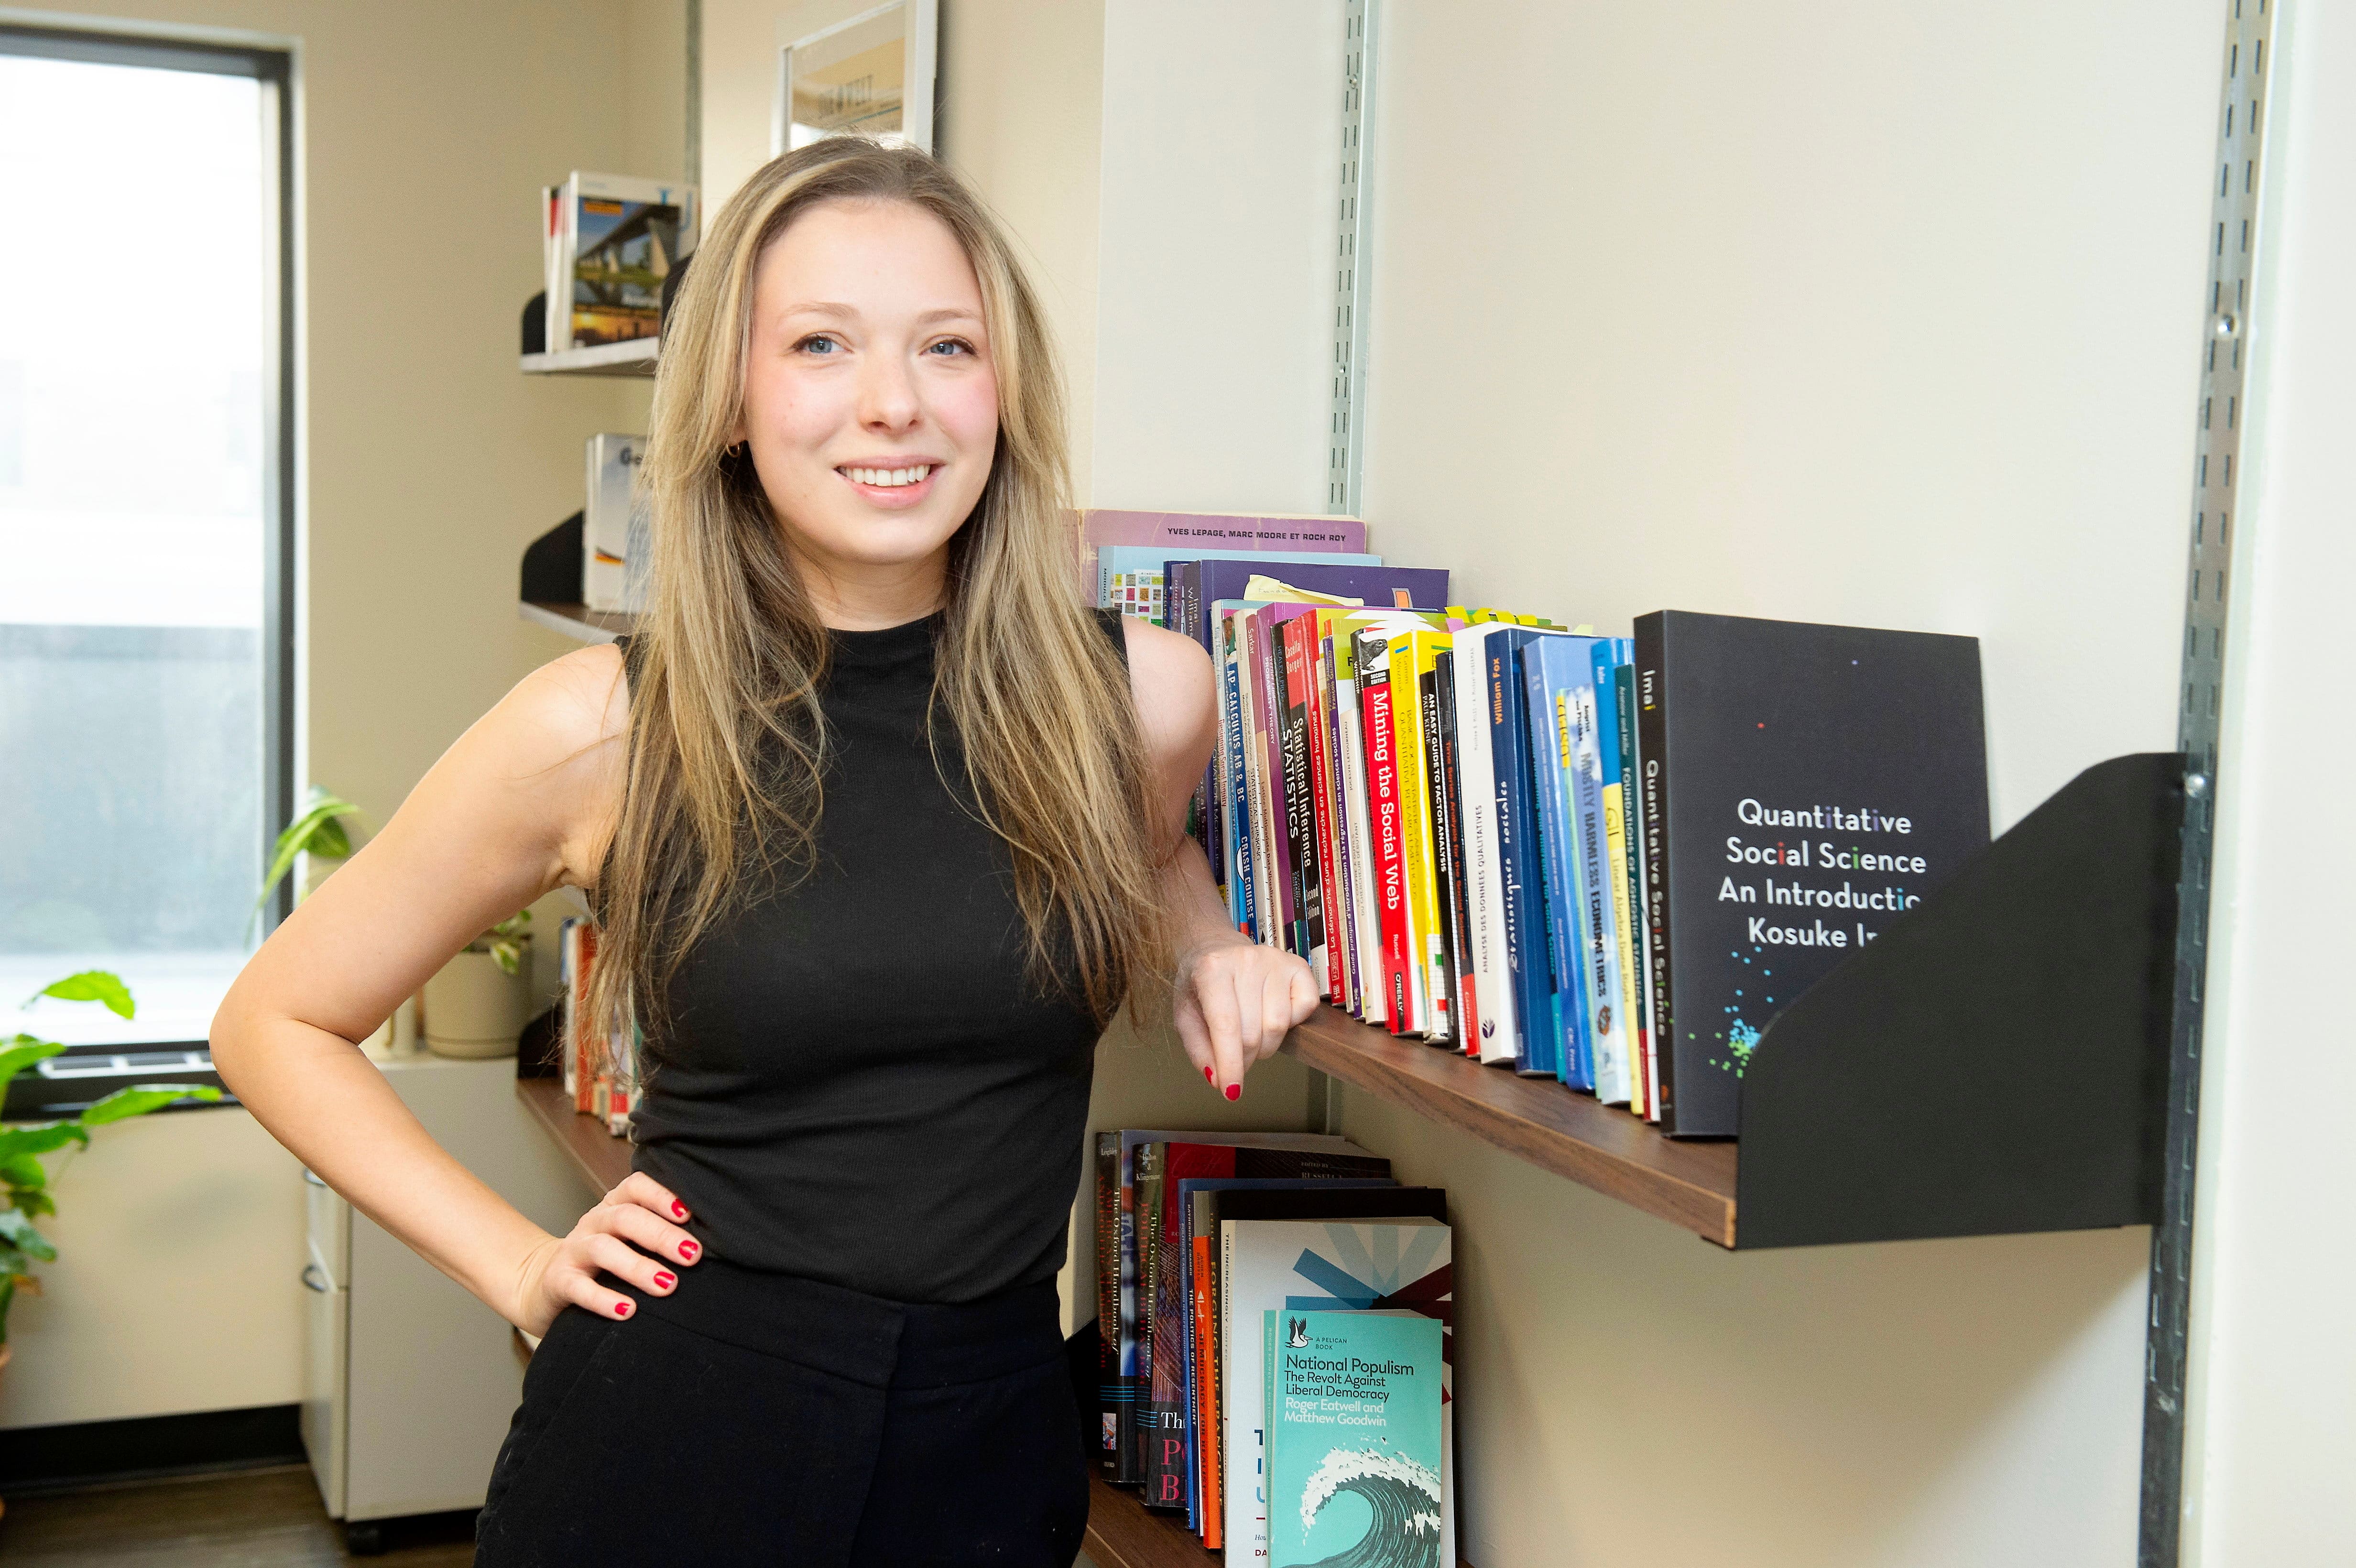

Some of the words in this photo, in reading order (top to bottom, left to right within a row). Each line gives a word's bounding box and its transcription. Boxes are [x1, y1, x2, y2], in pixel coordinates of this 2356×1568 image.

[1192, 529, 1226, 538] LEPAGE,
[1285, 640, 1301, 658] Casella
[1286, 657, 1302, 674] Berger
[1265, 656, 1273, 710] PROBABILITY
[1370, 671, 1386, 679] SECOND
[1643, 670, 1657, 710] Imai
[1229, 691, 1240, 749] CALCULUS
[1494, 682, 1503, 725] William
[1374, 690, 1390, 762] Mining
[1234, 754, 1243, 769] AB
[1294, 717, 1309, 795] Statistical
[1316, 755, 1324, 794] sciences
[1236, 773, 1243, 782] &
[1237, 787, 1244, 803] BC
[1283, 729, 1298, 838] STATISTICS
[1337, 791, 1342, 802] en
[1379, 765, 1392, 798] the
[1428, 693, 1435, 708] AN
[1434, 768, 1440, 783] TO
[1438, 826, 1447, 872] ANALYSIS
[1581, 752, 1595, 806] MOSTLY
[1320, 796, 1324, 808] en
[1496, 781, 1510, 843] sociales
[1622, 767, 1635, 853] FOUNDATIONS
[1737, 798, 1912, 834] Quantitative
[1299, 797, 1311, 867] Inference
[1320, 809, 1328, 859] recherche
[1381, 802, 1397, 861] Social
[1475, 805, 1484, 867] QUALITATIVES
[1646, 759, 1660, 885] Quantitative
[1241, 836, 1250, 873] CRASH
[1341, 845, 1346, 854] la
[1584, 812, 1600, 887] HARMLESS
[1628, 856, 1635, 873] OF
[1726, 836, 1809, 867] Social
[1819, 842, 1926, 873] Science
[1244, 876, 1254, 919] COURSE
[1343, 861, 1352, 918] d'introduction
[1385, 863, 1400, 910] Web
[1477, 870, 1485, 912] DONNÉES
[1718, 876, 1756, 903] An
[1767, 878, 1921, 911] Introductio
[1325, 886, 1334, 934] démarche
[1505, 858, 1521, 973] Statistiques
[1651, 890, 1666, 951] Social
[1331, 936, 1335, 948] La
[1590, 891, 1607, 997] ECONOMETRICS
[1748, 916, 1847, 947] Kosuke
[1395, 973, 1403, 1012] O'REILLY
[1654, 957, 1667, 1036] Science
[1112, 1338, 1119, 1354] of
[1190, 1351, 1195, 1363] OF
[1287, 1354, 1347, 1372] National
[1352, 1358, 1414, 1376] Populism
[1145, 1365, 1150, 1382] of
[1284, 1370, 1305, 1382] The
[1308, 1372, 1342, 1384] Revolt
[1344, 1374, 1385, 1389] Against
[1286, 1384, 1323, 1396] Liberal
[1326, 1386, 1389, 1403] Democracy
[1286, 1397, 1318, 1413] Roger
[1321, 1399, 1361, 1411] Eatwell
[1363, 1401, 1384, 1413] and
[1161, 1412, 1185, 1429] Th
[1284, 1411, 1334, 1424] Matthew
[1337, 1413, 1386, 1426] Goodwin
